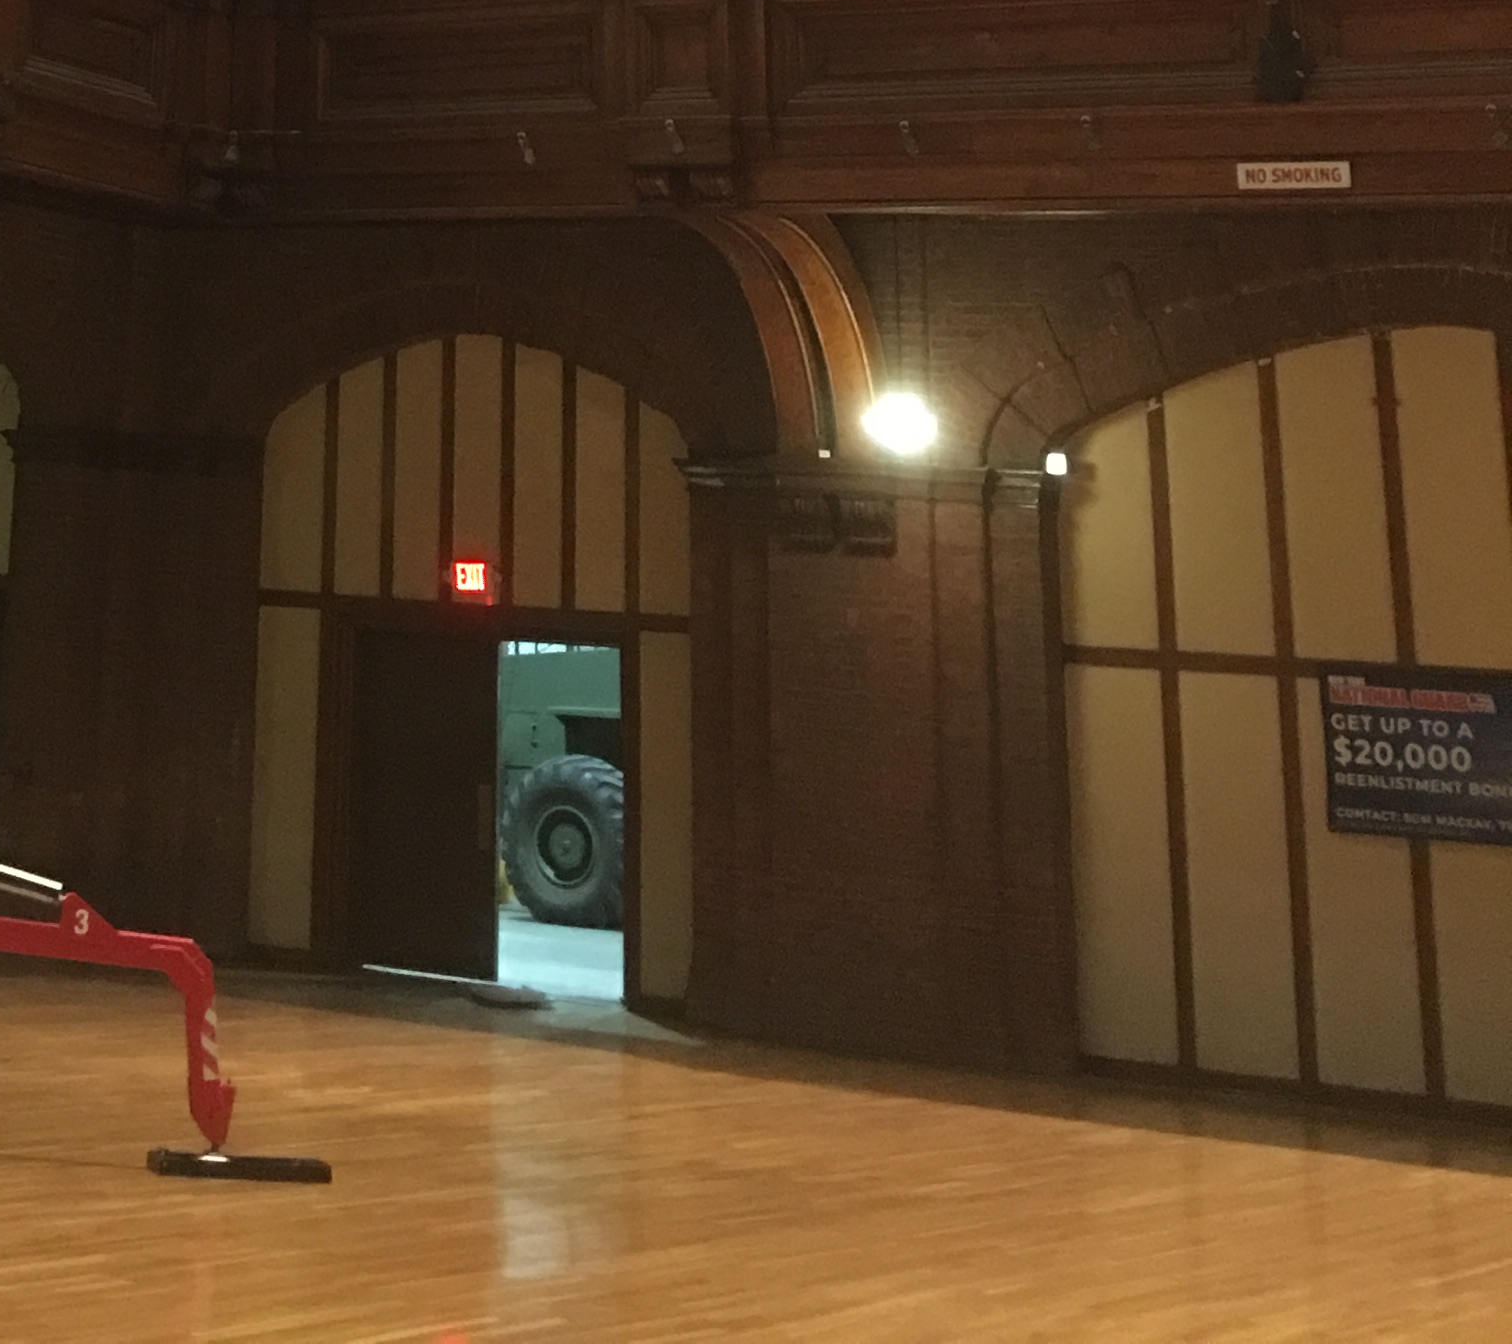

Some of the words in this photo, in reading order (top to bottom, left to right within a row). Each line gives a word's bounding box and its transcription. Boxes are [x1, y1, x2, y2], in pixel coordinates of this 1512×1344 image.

[1245, 168, 1267, 184] NO
[1271, 166, 1343, 184] SMOKING
[455, 562, 486, 591] EXIT
[1330, 713, 1373, 733] GET
[1379, 716, 1412, 734] UP
[1419, 719, 1450, 738] TO
[1457, 721, 1474, 740] A
[1333, 734, 1472, 773] $20,000
[1334, 772, 1464, 795] REENLISTMENT
[74, 909, 90, 934] 3
